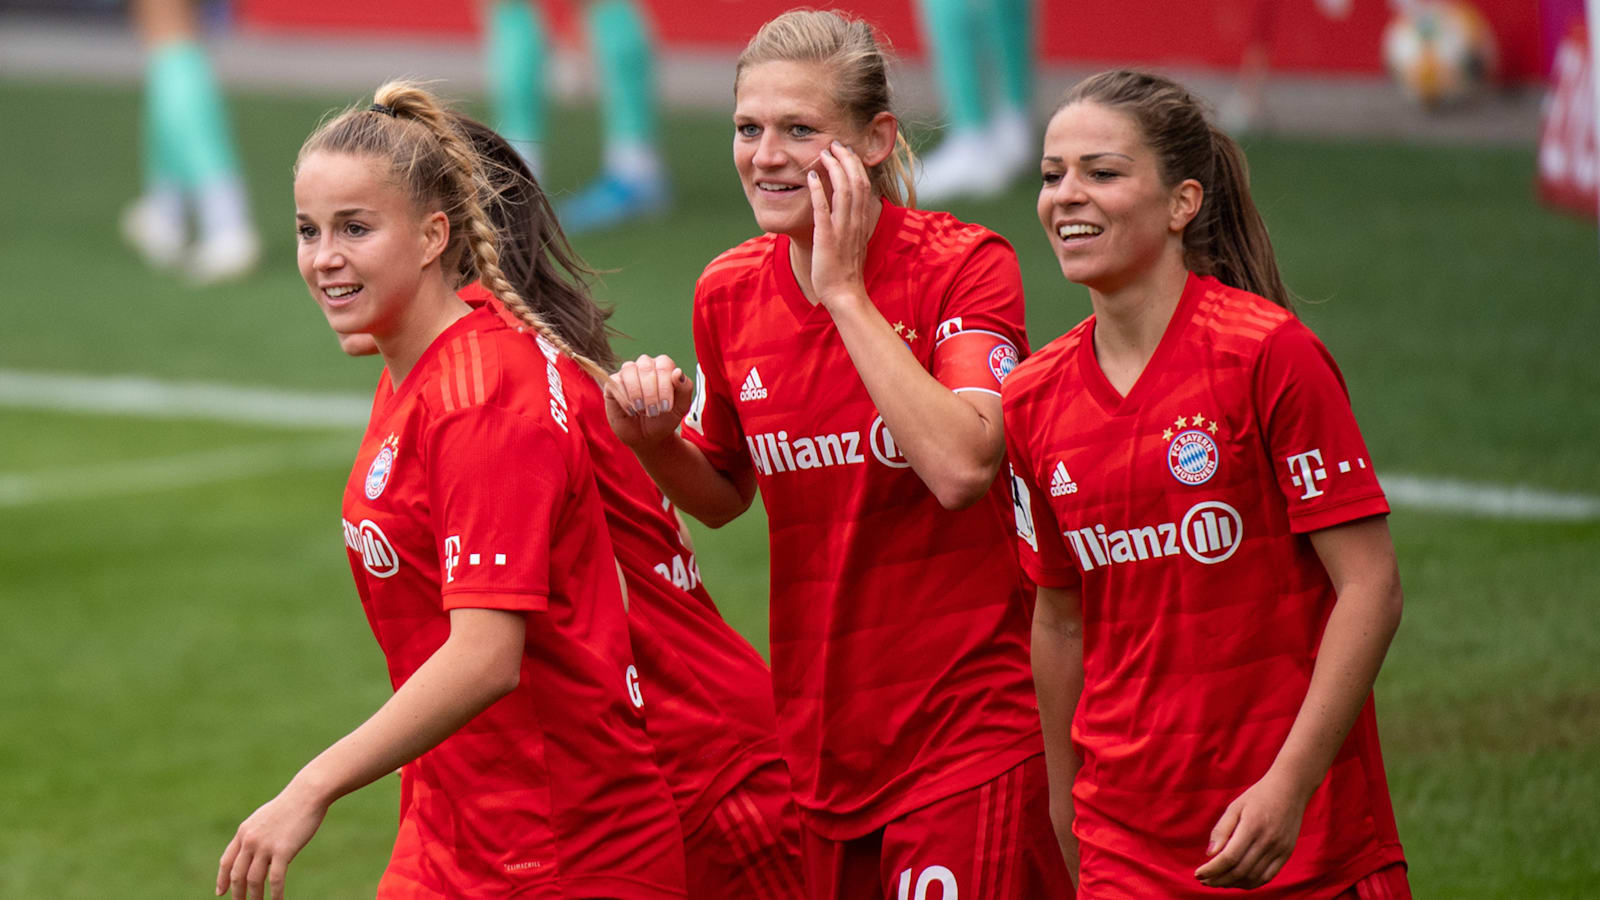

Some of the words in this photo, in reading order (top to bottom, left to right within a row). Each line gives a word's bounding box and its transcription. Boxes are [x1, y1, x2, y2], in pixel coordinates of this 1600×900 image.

[740, 387, 768, 402] adidas
[1179, 434, 1214, 452] BAYERN
[1050, 481, 1078, 497] adidas
[1063, 523, 1181, 572] llianz
[898, 864, 959, 900] 10
